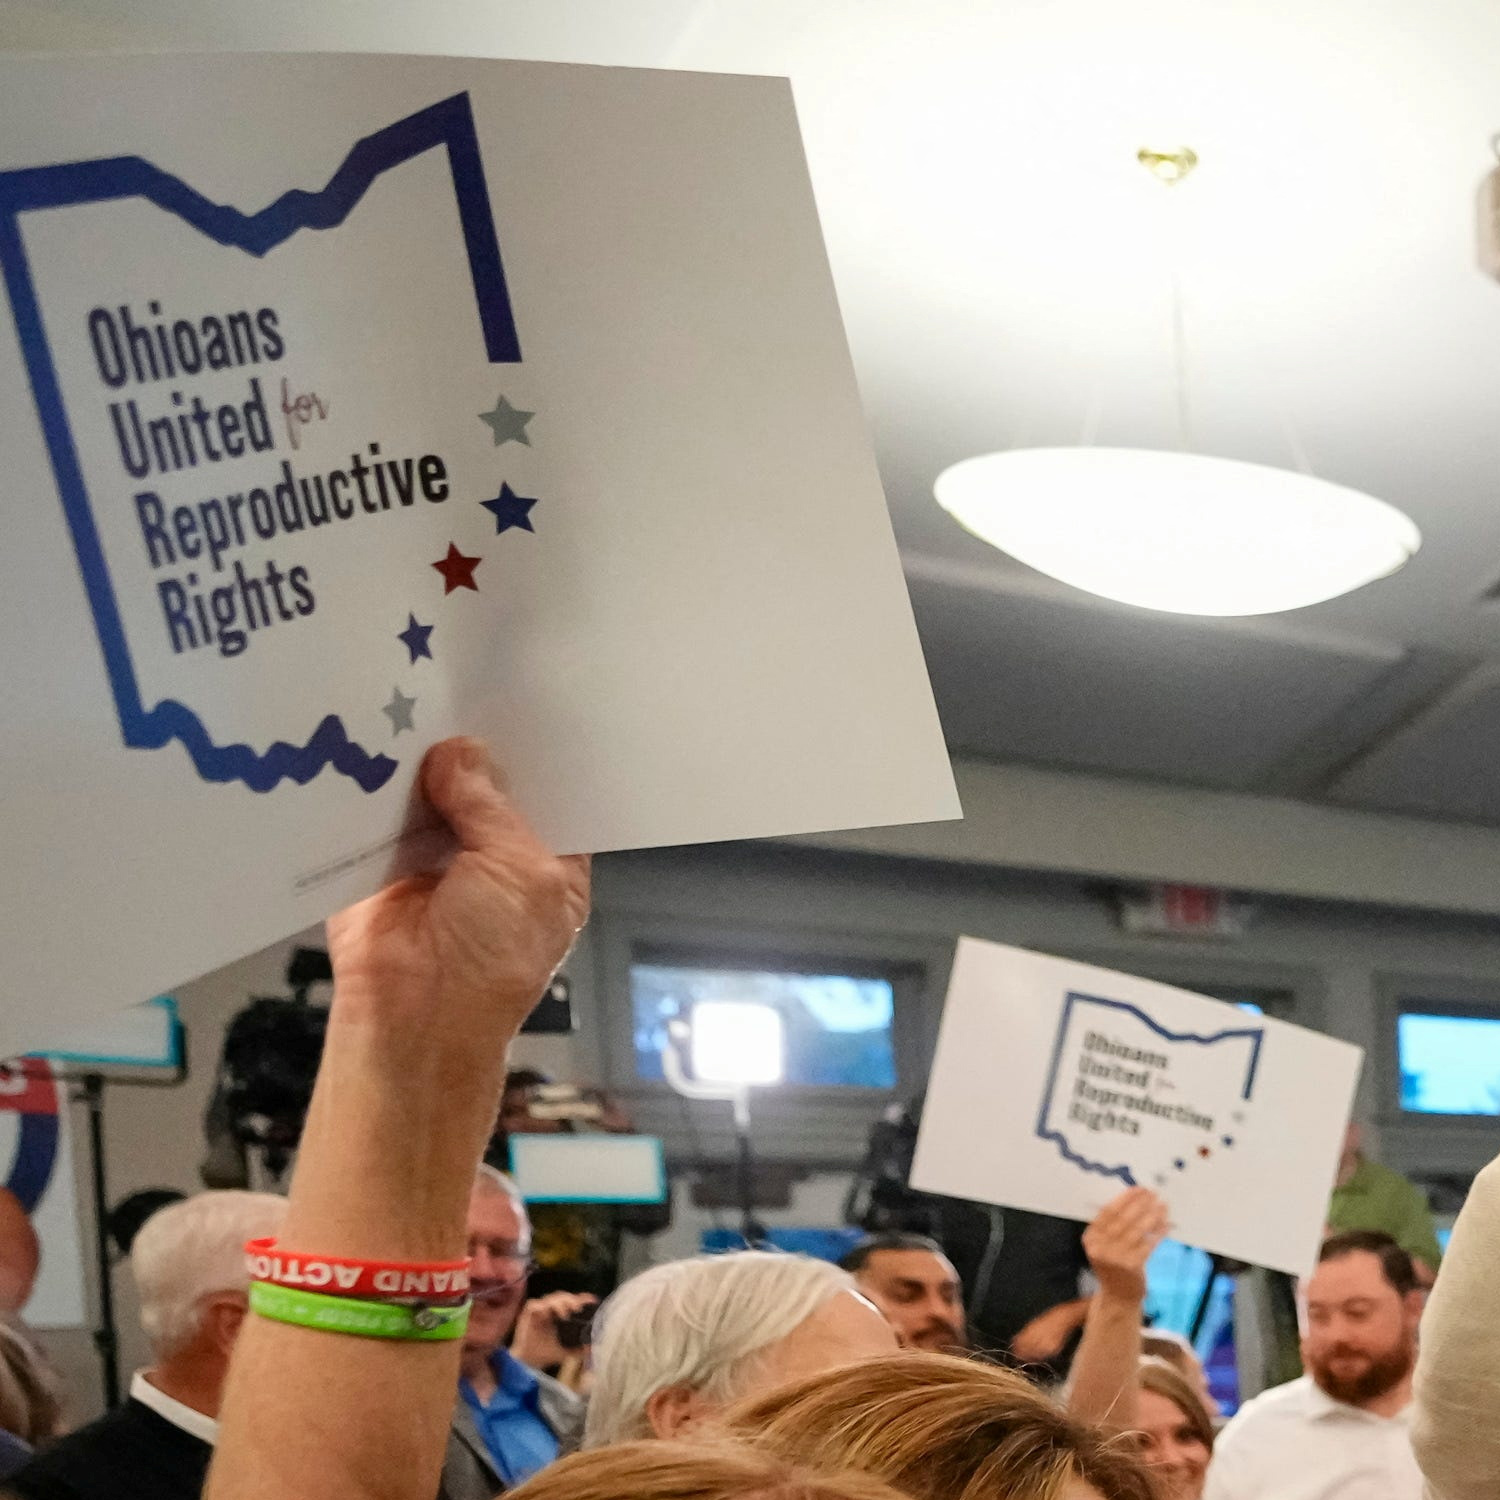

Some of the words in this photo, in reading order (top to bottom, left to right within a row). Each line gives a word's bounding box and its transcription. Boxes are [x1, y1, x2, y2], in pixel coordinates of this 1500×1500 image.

[87, 301, 284, 387] Ohioans
[110, 377, 274, 479] United
[280, 376, 330, 451] for
[133, 443, 450, 570] Reproductive
[157, 562, 317, 657] Rights
[372, 1267, 470, 1293] MAND
